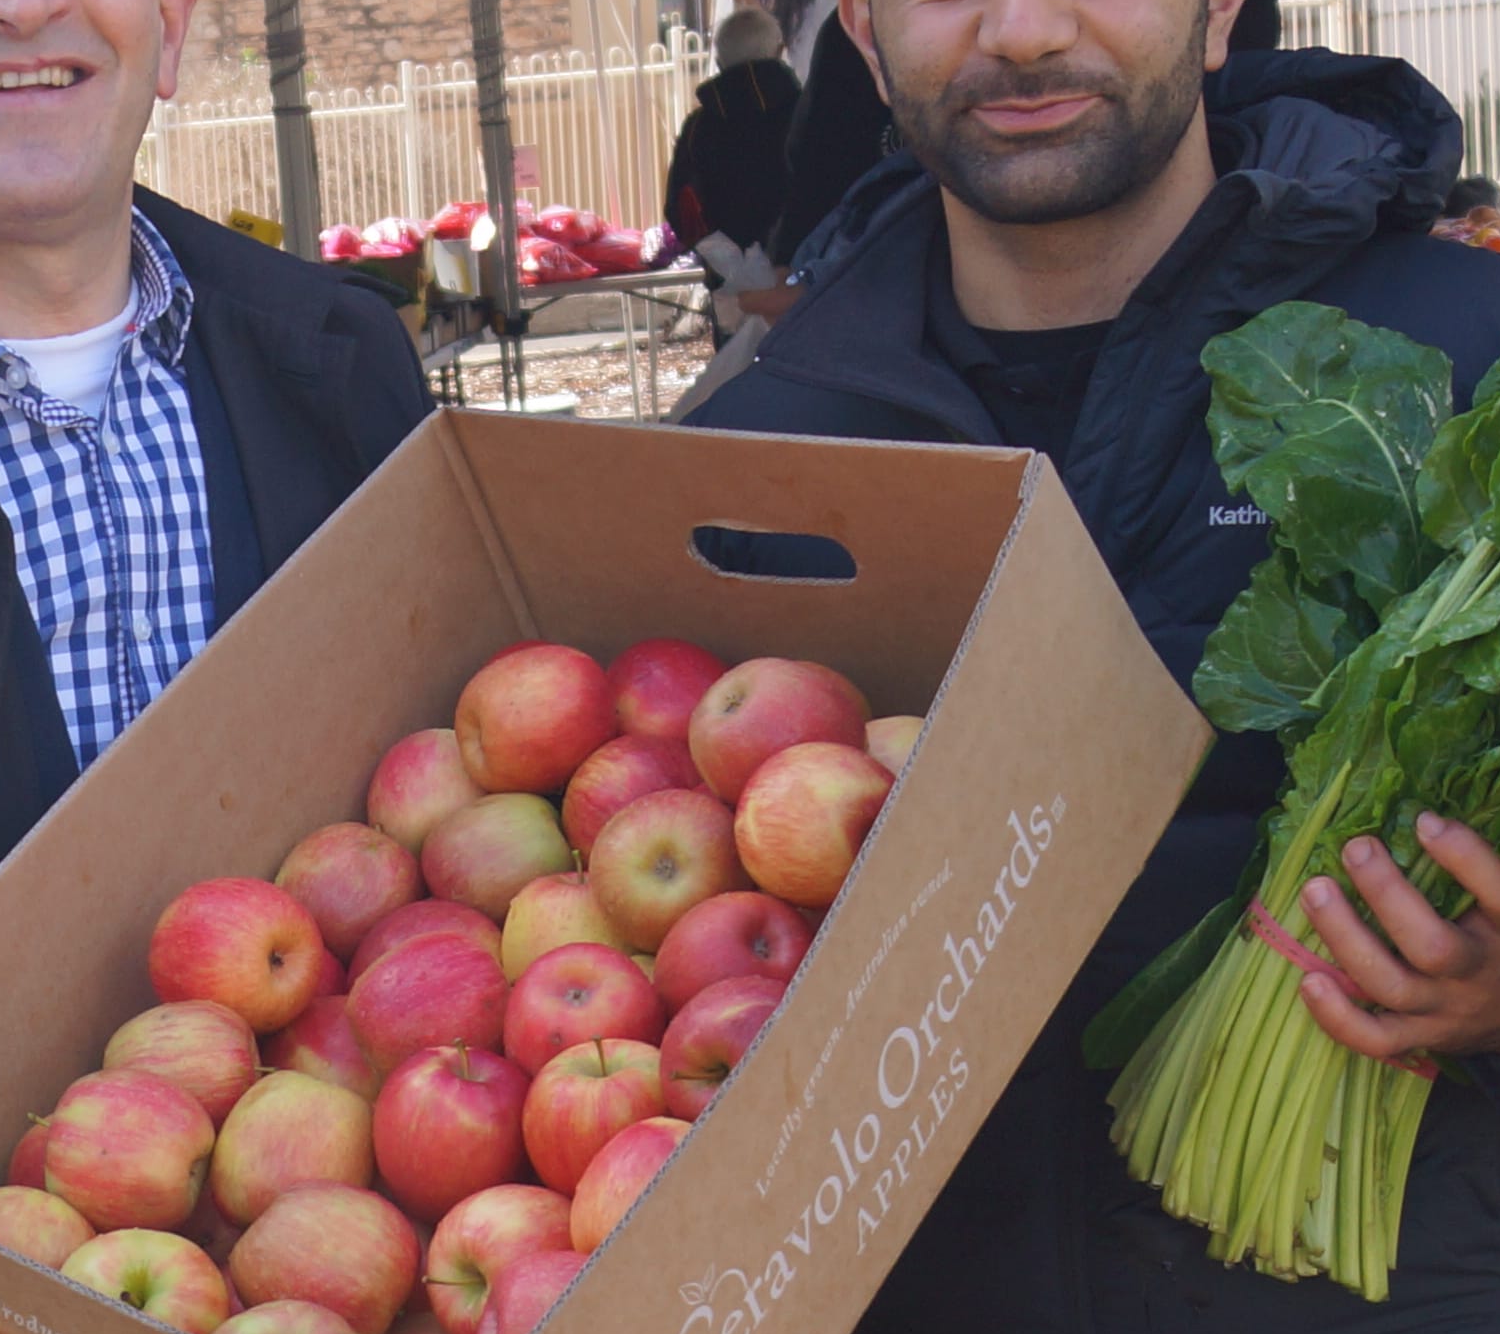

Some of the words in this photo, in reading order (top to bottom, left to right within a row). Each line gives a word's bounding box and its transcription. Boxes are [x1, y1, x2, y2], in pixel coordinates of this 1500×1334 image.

[754, 1106, 802, 1199] Locally
[846, 913, 909, 1020] Australian
[875, 801, 1054, 1109] Orchards
[854, 1047, 972, 1255] APPLES
